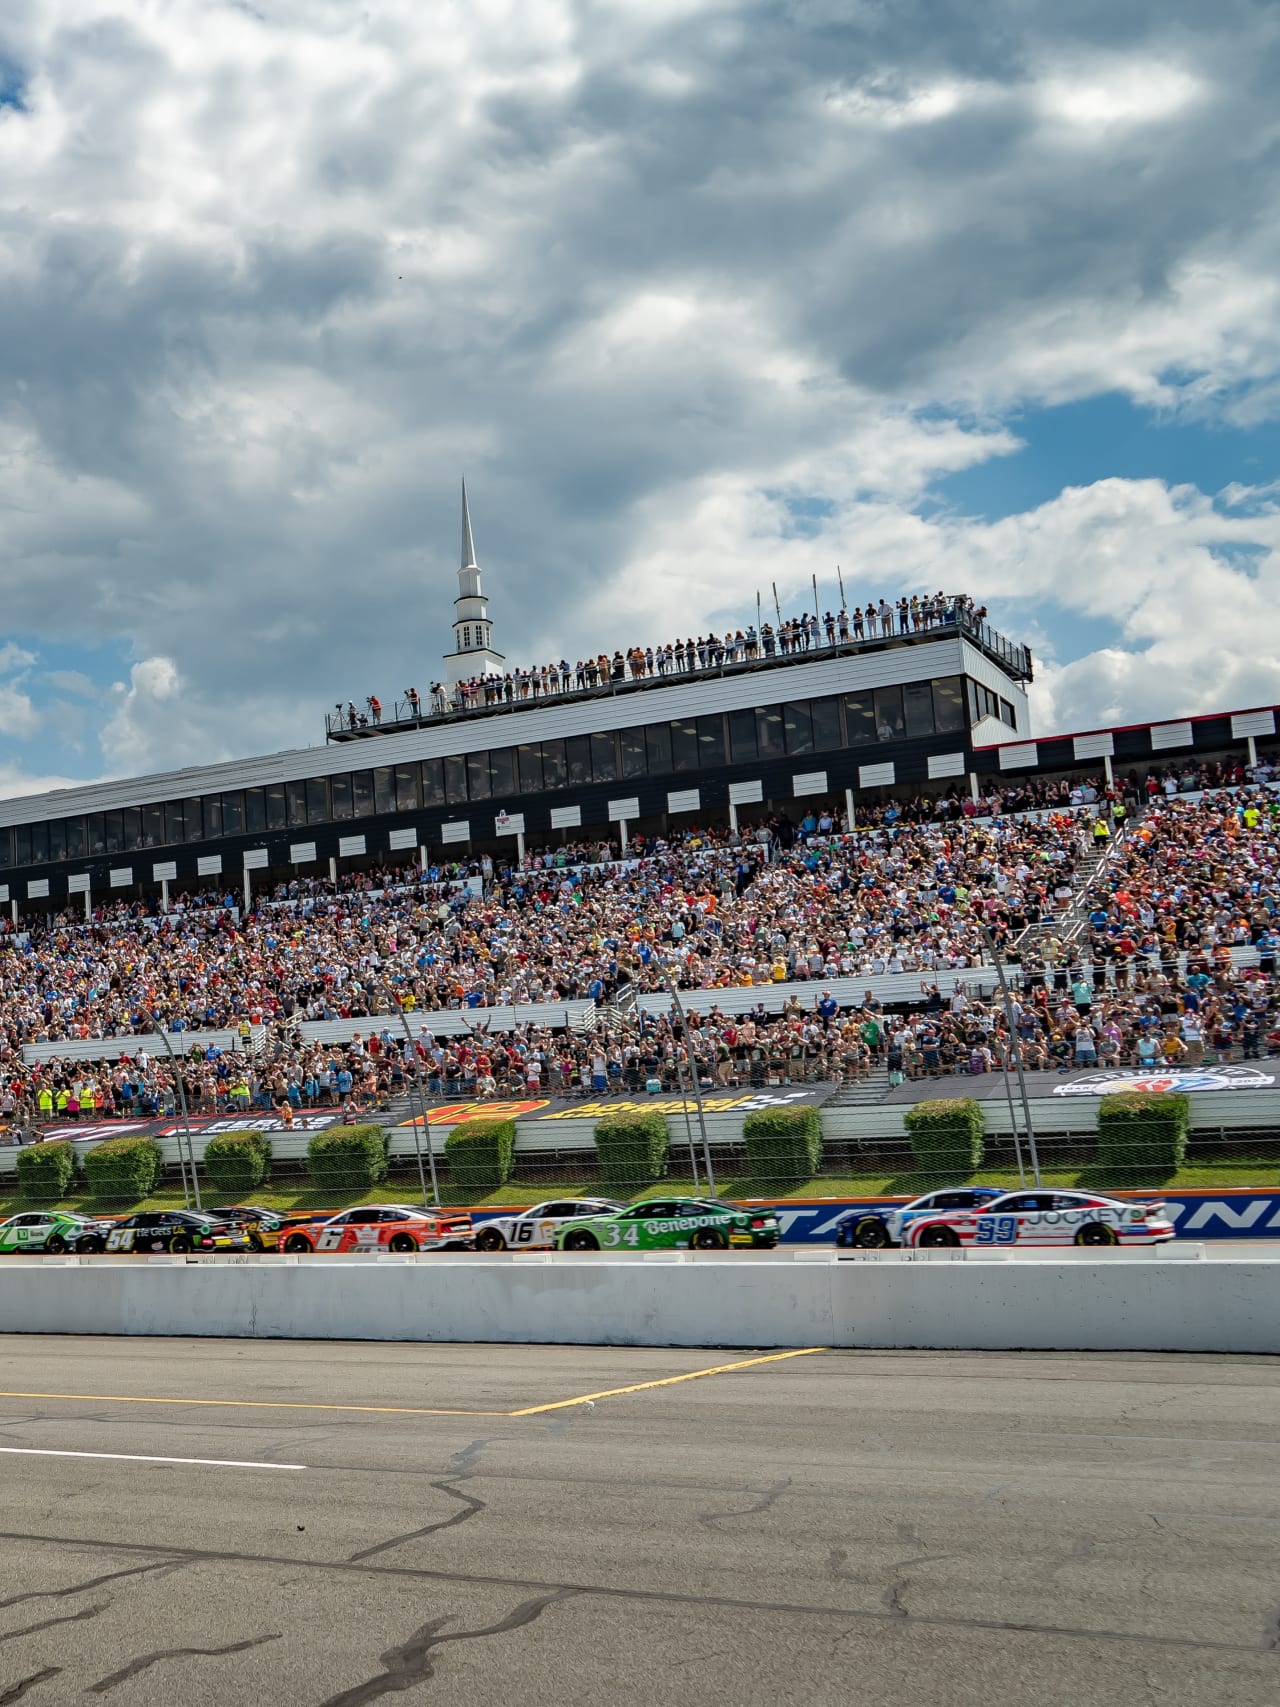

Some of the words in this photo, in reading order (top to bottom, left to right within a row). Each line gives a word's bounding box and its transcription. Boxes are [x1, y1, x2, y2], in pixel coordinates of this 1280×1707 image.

[643, 1215, 732, 1235] Benebone
[1026, 1208, 1129, 1225] JOCKEY
[105, 1229, 136, 1250] 54
[510, 1222, 534, 1242] 16
[603, 1223, 640, 1247] 34
[975, 1216, 1018, 1244] 99
